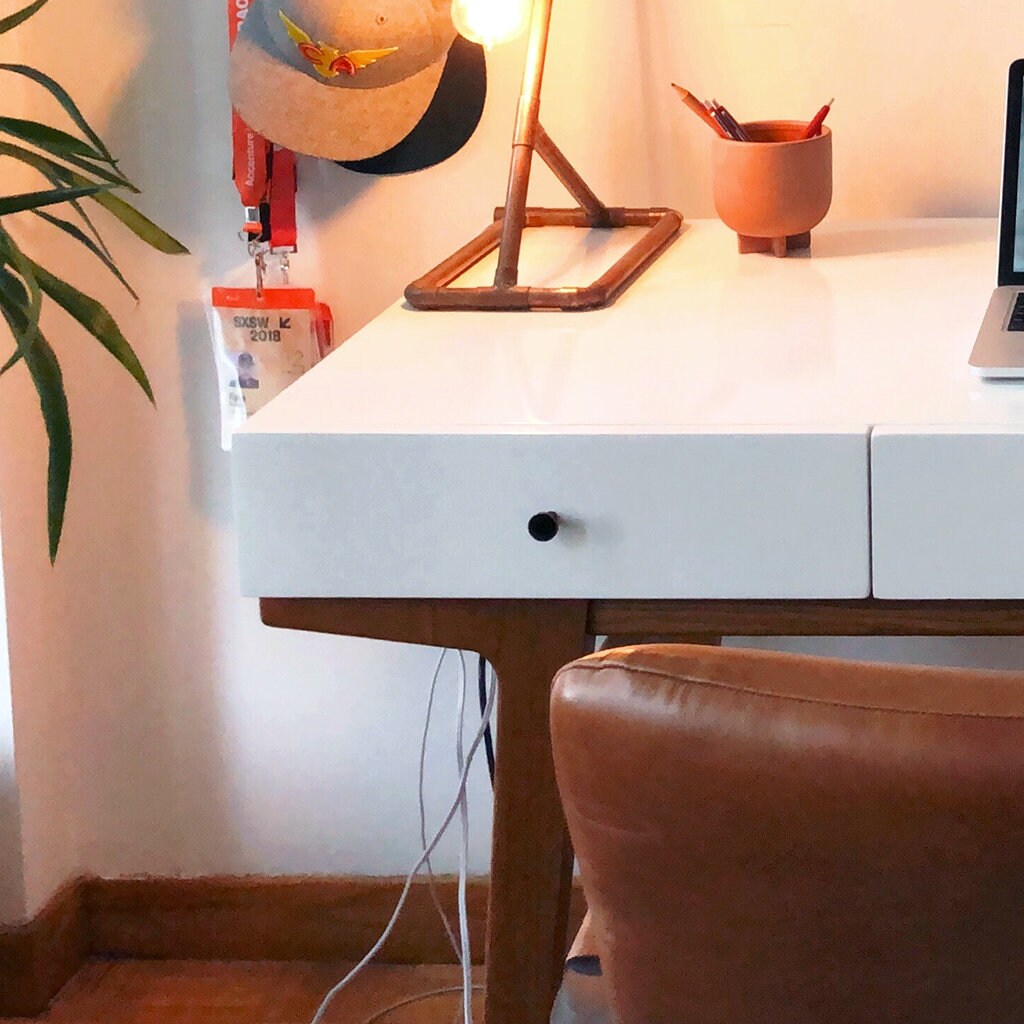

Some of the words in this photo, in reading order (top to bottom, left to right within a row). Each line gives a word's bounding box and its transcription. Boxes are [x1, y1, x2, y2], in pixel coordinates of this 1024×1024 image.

[245, 133, 255, 187] Accenture
[233, 316, 269, 329] SXSW
[250, 330, 281, 342] 2018
